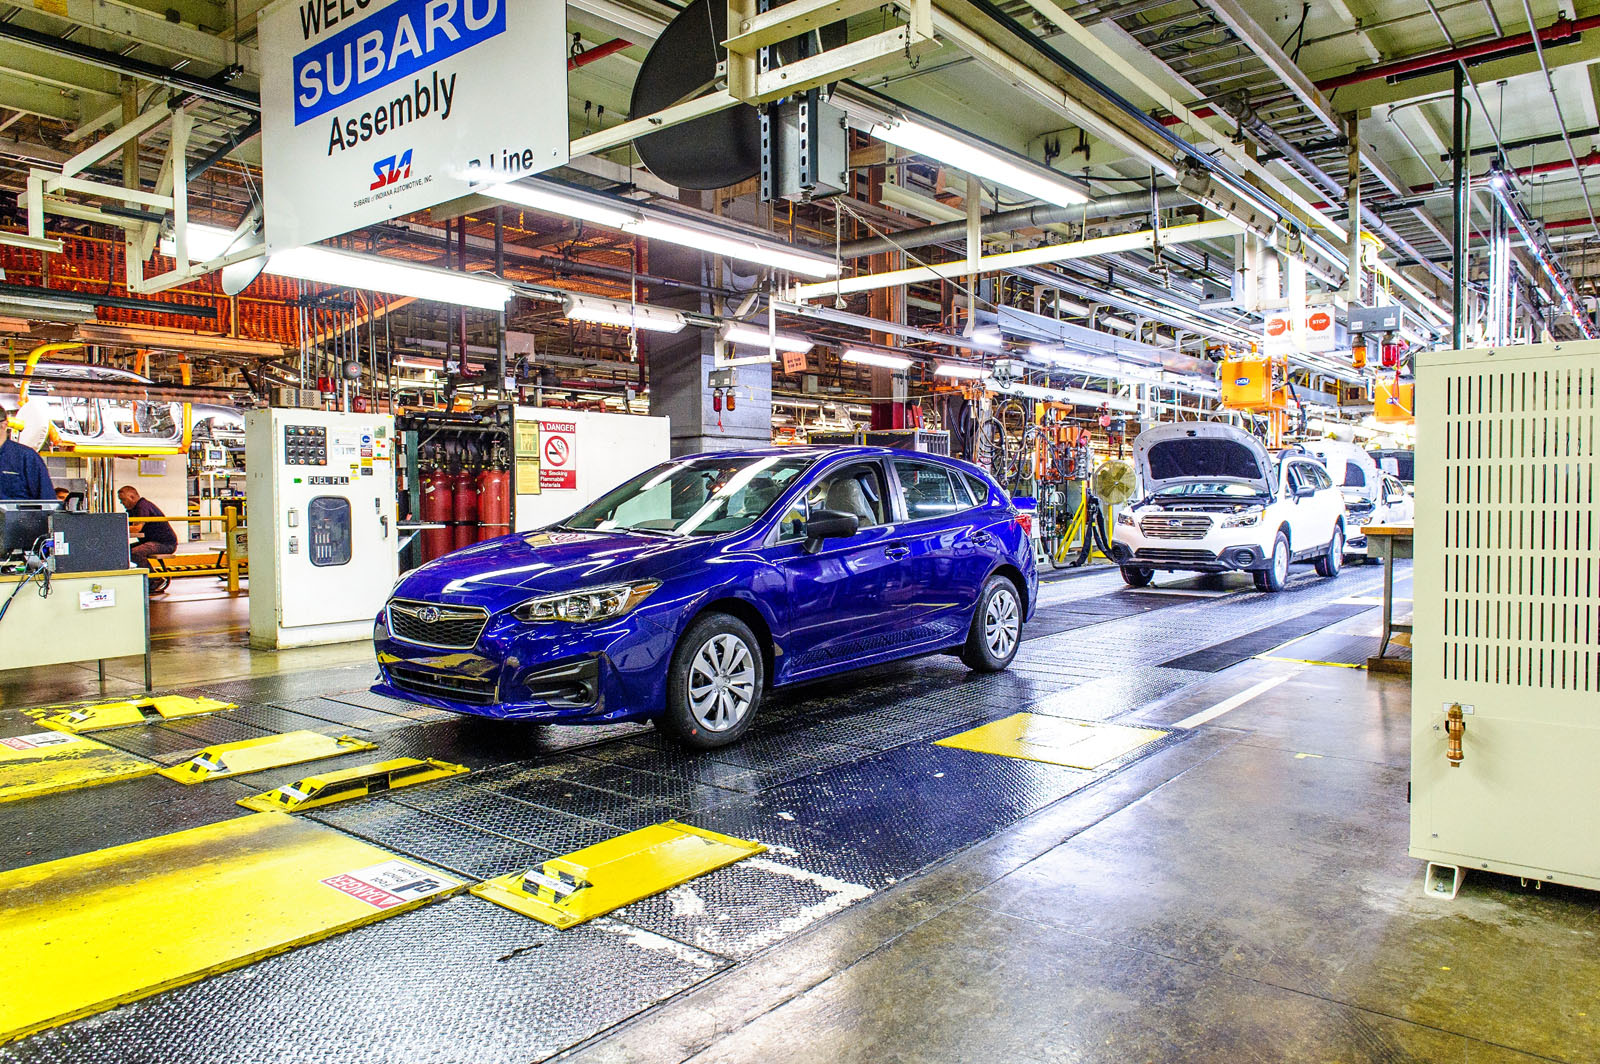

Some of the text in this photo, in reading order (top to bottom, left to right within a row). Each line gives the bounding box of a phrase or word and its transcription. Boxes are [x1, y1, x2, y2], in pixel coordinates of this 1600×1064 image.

[299, 0, 497, 108] SUBARU
[328, 71, 457, 156] Assembly
[353, 197, 371, 207] SUBARU
[375, 189, 393, 201] INDIANA
[546, 423, 575, 431] DANGER
[309, 476, 349, 485] FUEL FILL
[331, 875, 381, 900] DANGER
